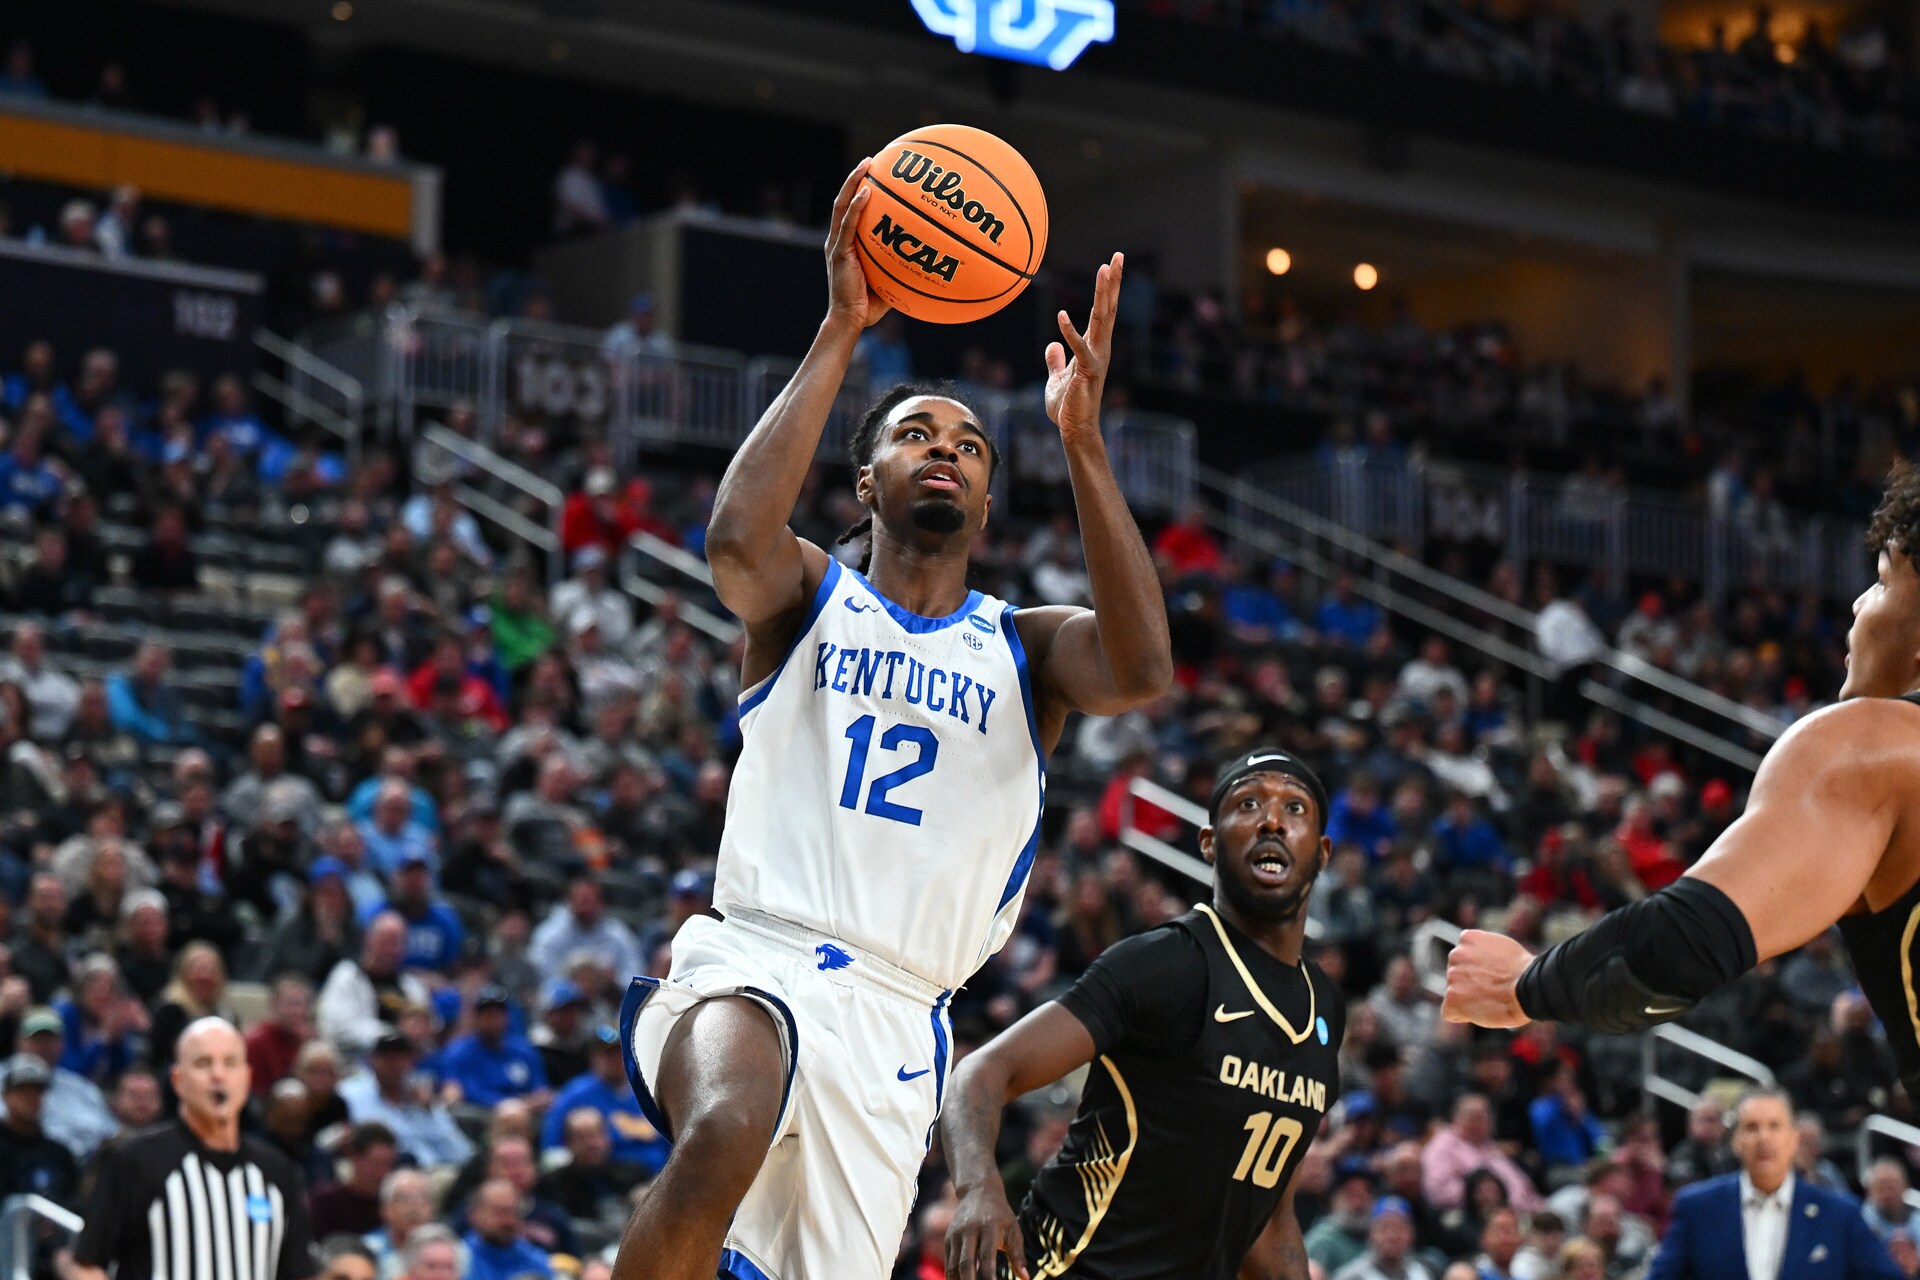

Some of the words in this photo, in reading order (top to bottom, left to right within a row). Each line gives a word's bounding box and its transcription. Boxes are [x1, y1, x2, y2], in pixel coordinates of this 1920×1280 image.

[891, 149, 1005, 245] Wilson
[920, 194, 938, 208] EVO
[939, 206, 957, 220] NXT
[872, 214, 960, 283] NCAA
[963, 633, 983, 650] SEC
[971, 617, 995, 632] NCAA
[814, 642, 996, 735] KENTUCKY
[839, 714, 939, 826] 12
[1219, 1054, 1326, 1113] OAKLAND
[1232, 1110, 1303, 1189] 10
